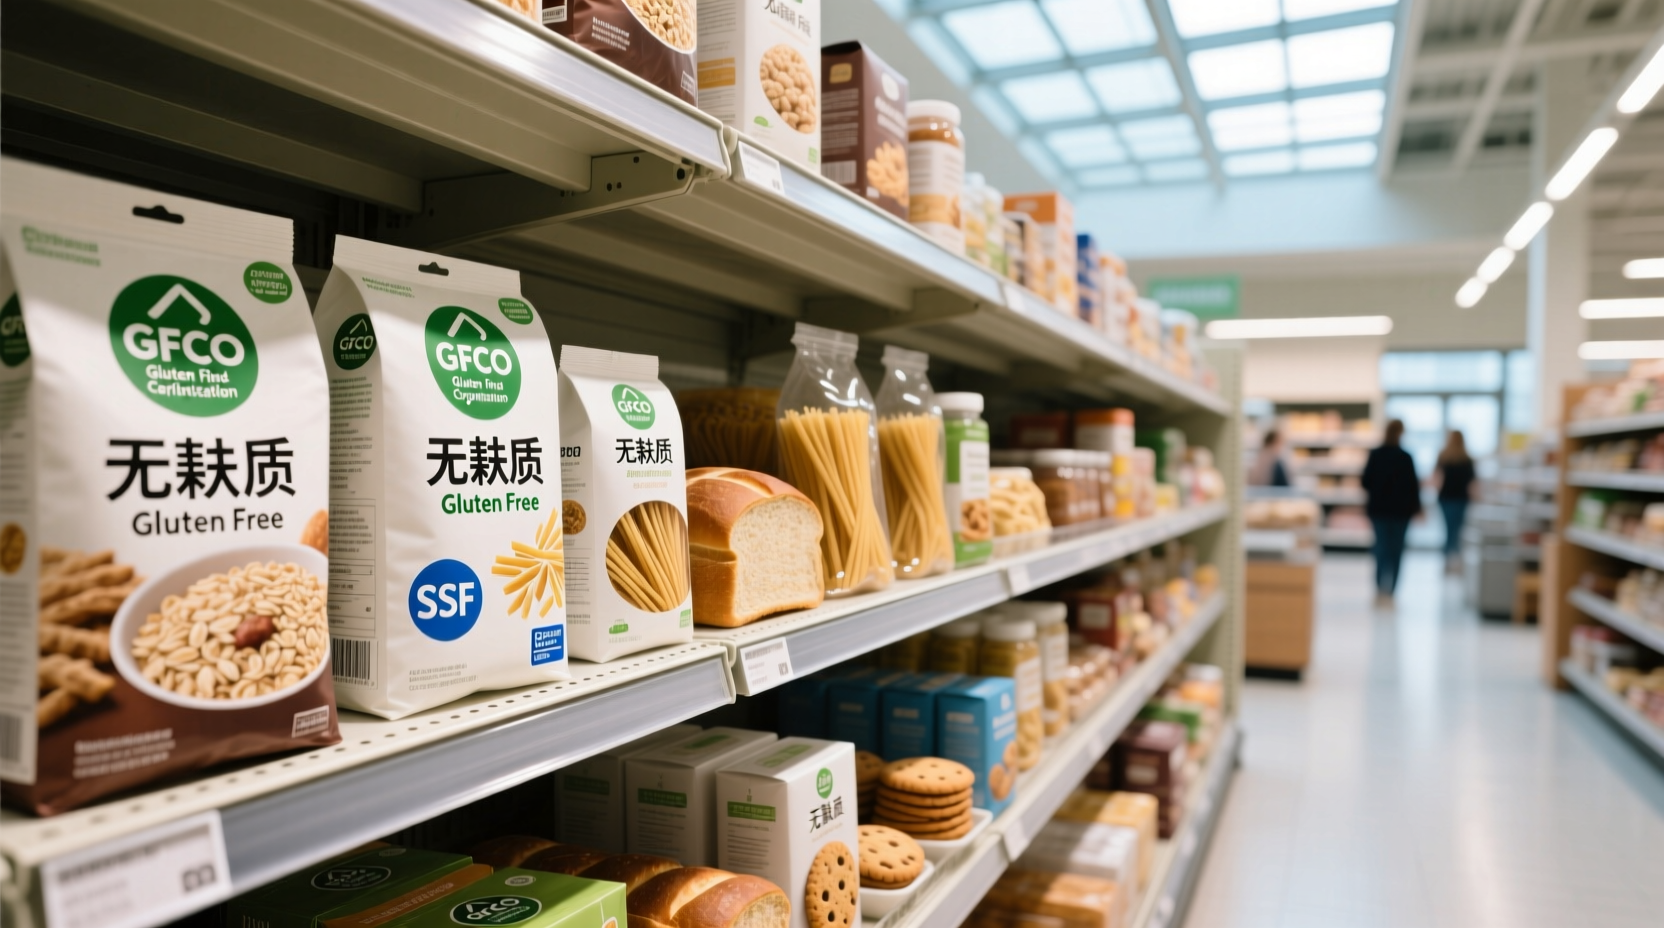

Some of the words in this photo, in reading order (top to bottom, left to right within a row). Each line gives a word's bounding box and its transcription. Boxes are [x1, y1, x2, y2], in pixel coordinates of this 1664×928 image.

[122, 322, 245, 367] GFCO
[436, 342, 512, 376] GFCO
[441, 493, 502, 515] Gluten
[506, 492, 539, 511] Free
[133, 510, 225, 536] Gluten
[233, 508, 284, 531] Free
[417, 582, 475, 620] SSF
